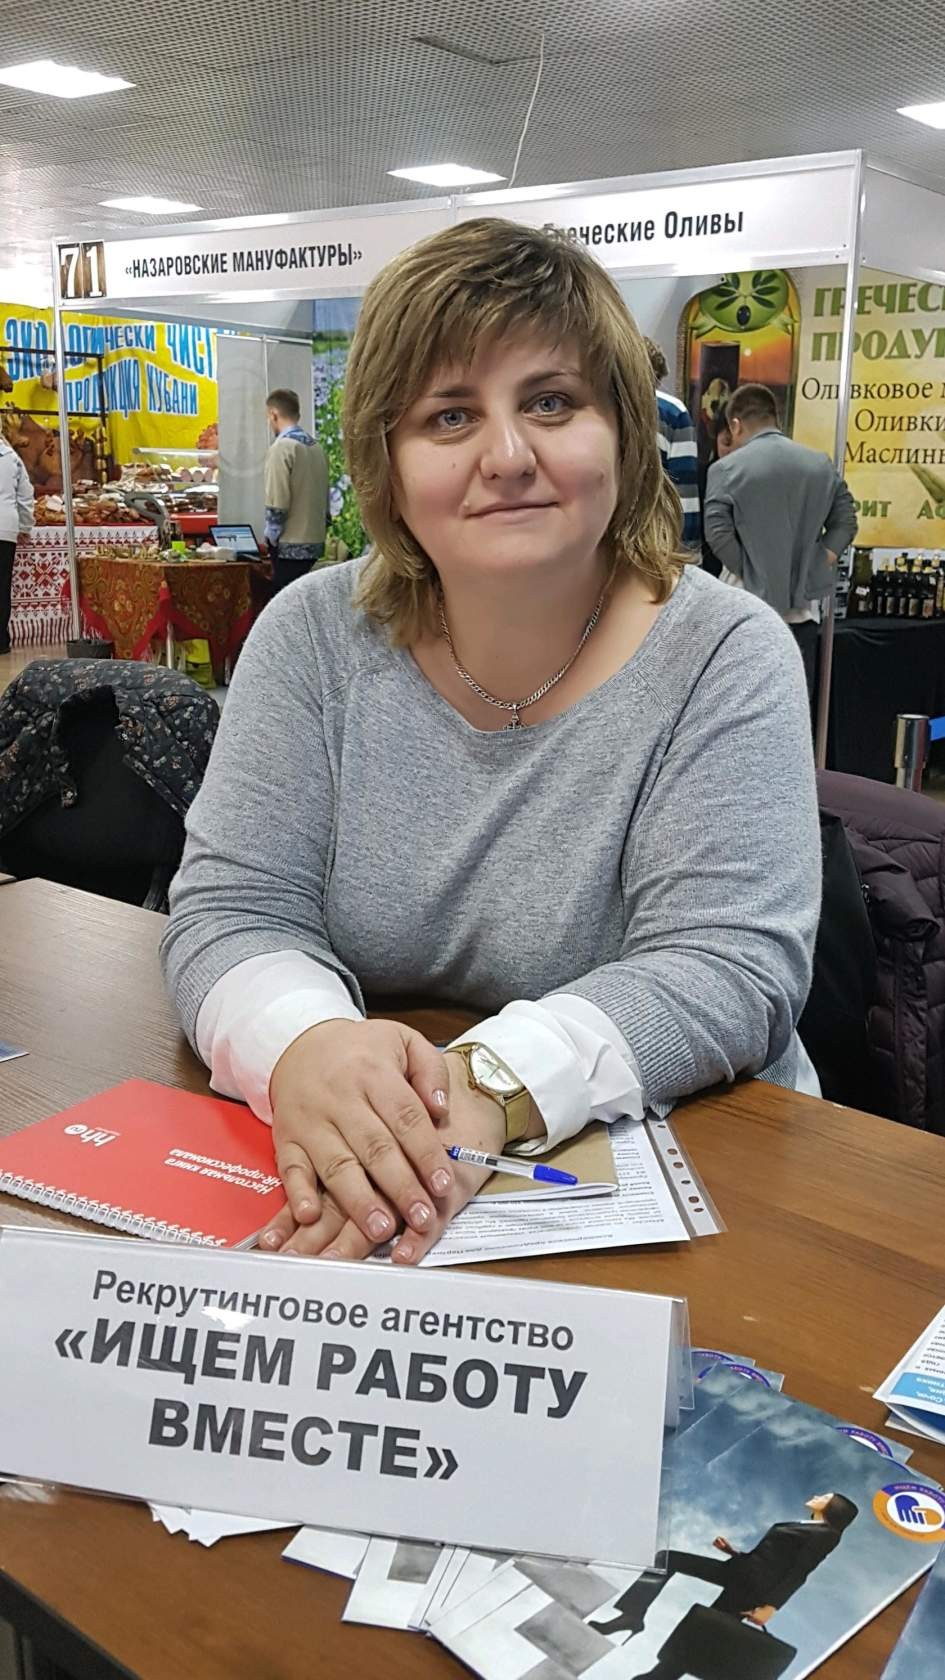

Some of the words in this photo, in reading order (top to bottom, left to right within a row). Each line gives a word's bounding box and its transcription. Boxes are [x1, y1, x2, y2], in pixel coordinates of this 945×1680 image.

[664, 211, 744, 239] Оливы
[60, 244, 104, 298] 71
[125, 253, 228, 279] «НАЗАРОВСКИЕ
[232, 243, 363, 273] МАНУФАКТУРЫ»
[813, 282, 945, 317] ГРЕЧЕС
[146, 362, 199, 414] КУБАНИ
[164, 1157, 200, 1173] книга
[169, 1148, 283, 1188] HR-профессионала
[200, 1165, 275, 1195] Настольная
[93, 1269, 369, 1329] Рекрутинговое
[381, 1307, 574, 1351] агентство
[55, 1317, 294, 1386] «ИЩЕМ
[317, 1343, 588, 1419] РАБОТУ
[149, 1397, 459, 1481] ВМЕСТЕ»
